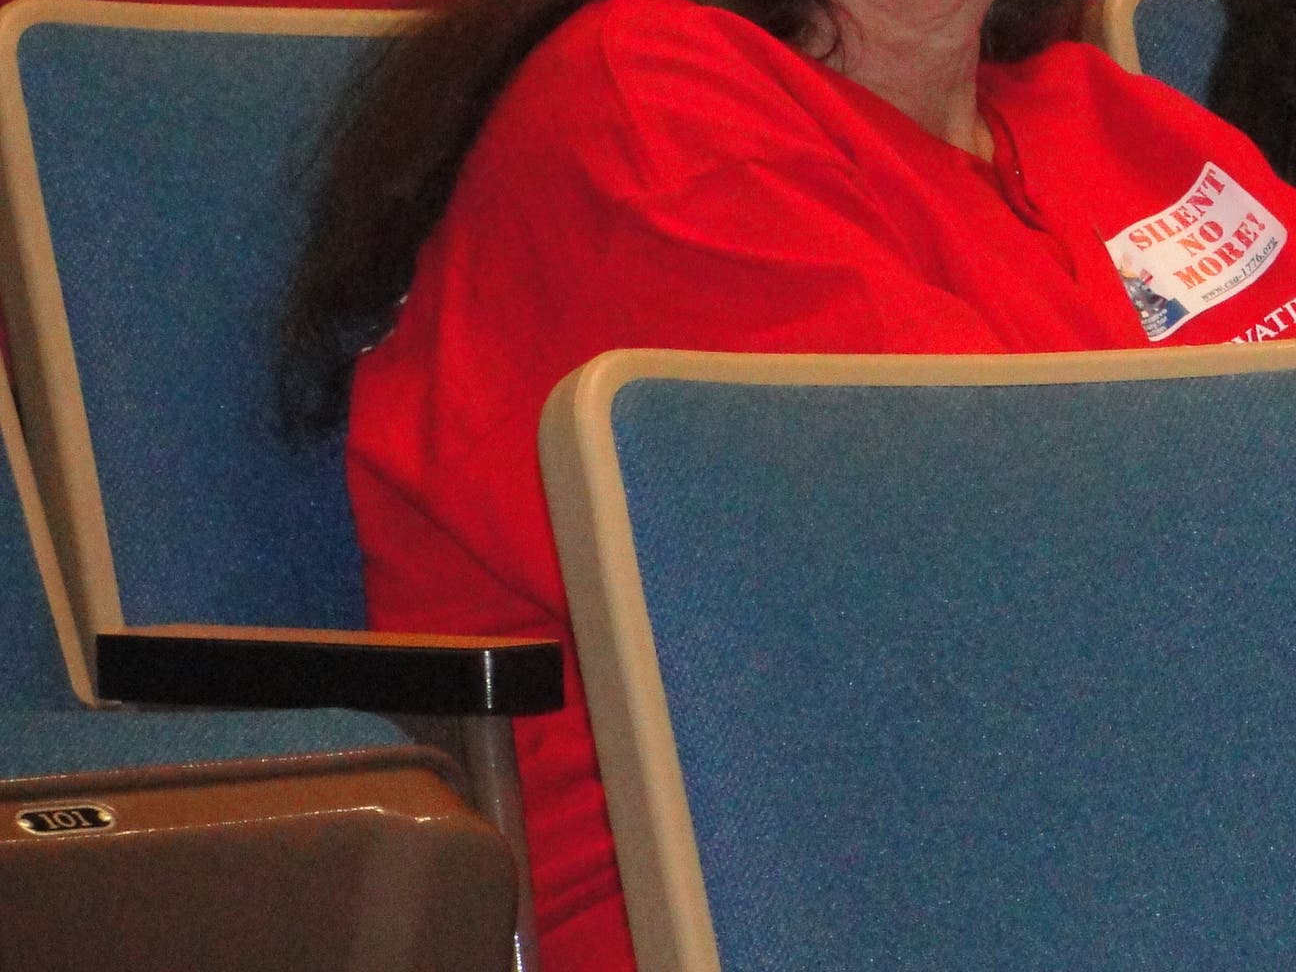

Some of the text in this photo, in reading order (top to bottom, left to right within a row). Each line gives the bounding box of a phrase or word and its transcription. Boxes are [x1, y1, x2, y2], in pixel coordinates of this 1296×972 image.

[1128, 169, 1226, 251] SILENT
[1177, 220, 1224, 257] NO
[1173, 212, 1266, 289] MORE!
[39, 810, 93, 829] 101
